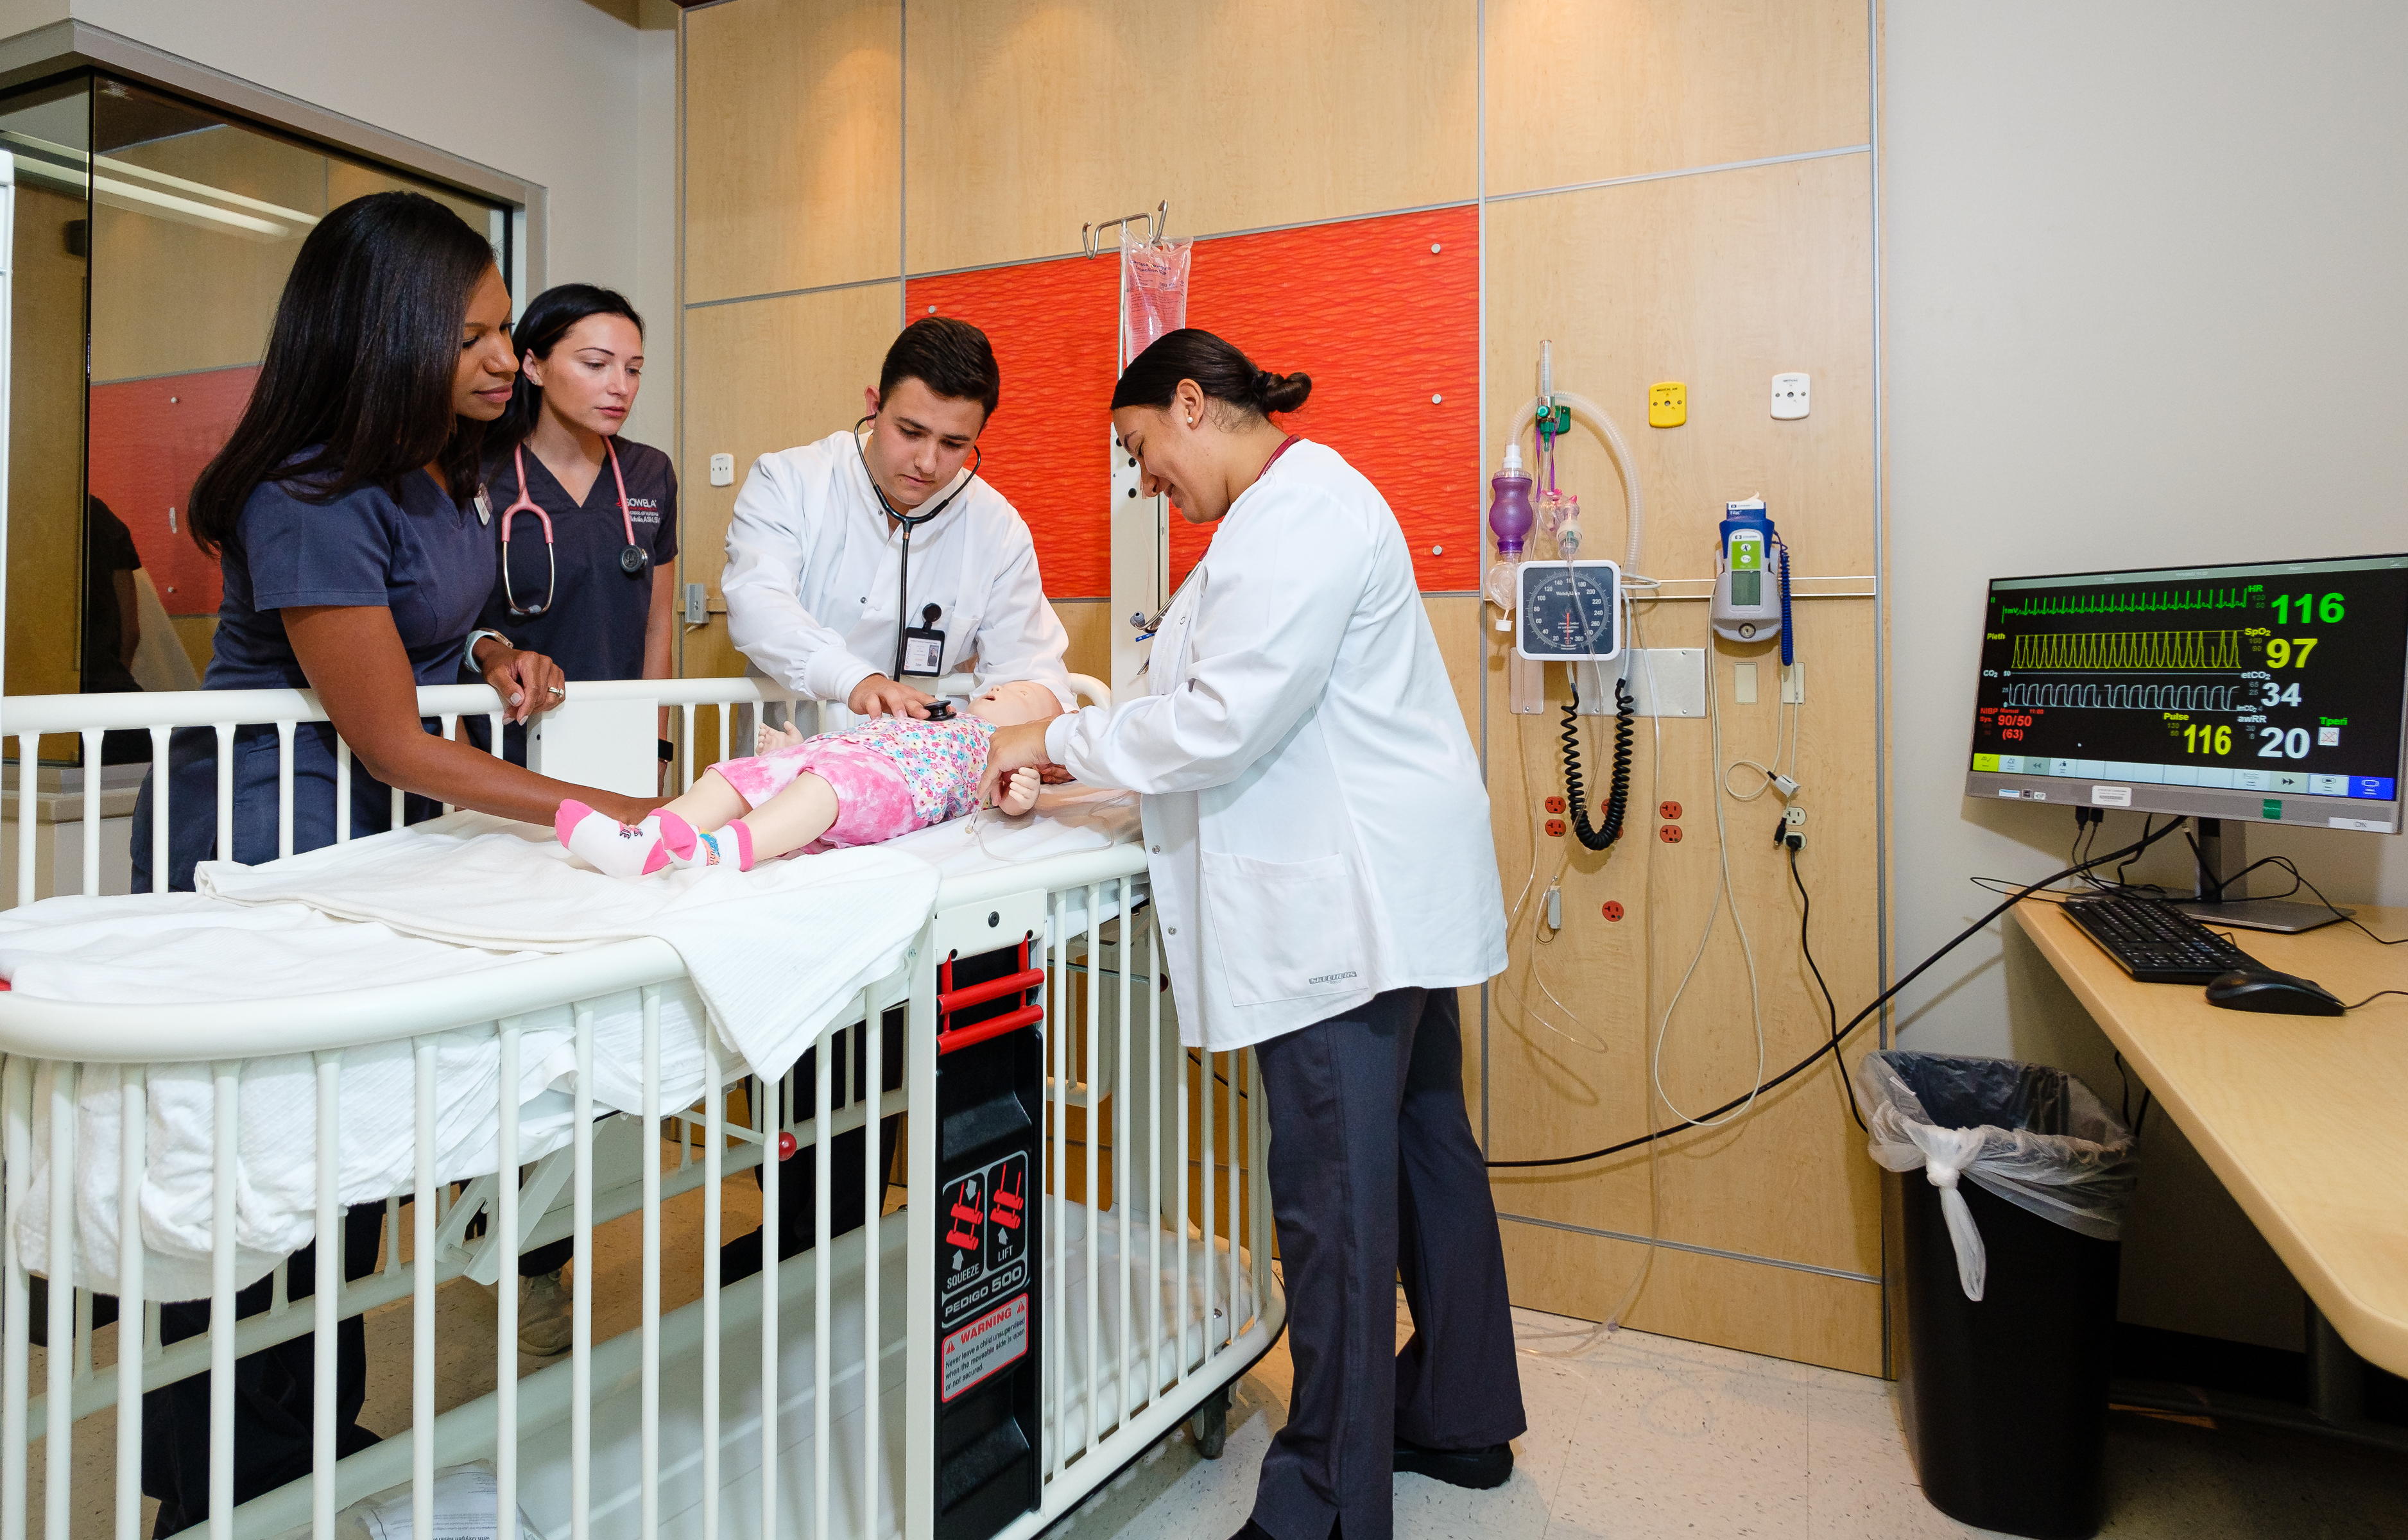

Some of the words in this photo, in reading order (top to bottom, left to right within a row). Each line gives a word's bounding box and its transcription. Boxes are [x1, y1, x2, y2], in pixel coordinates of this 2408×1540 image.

[626, 498, 657, 508] SOWELA
[2271, 592, 2345, 624] 116
[2266, 638, 2318, 669] 97
[2260, 682, 2303, 707] 34
[1998, 715, 2032, 726] 90/50
[2237, 715, 2267, 723] awRR
[2319, 717, 2348, 726] Tperi
[2002, 729, 2024, 741] (63)
[2183, 724, 2232, 755] 116
[2257, 726, 2310, 759] 20
[1309, 971, 1357, 984] SKECHERS
[998, 1245, 1013, 1262] LIFT
[947, 1263, 979, 1289] SQUEEZE
[945, 1286, 988, 1317] PEDIGO
[992, 1265, 1022, 1293] 500
[961, 1308, 1011, 1344] WARNING
[946, 1355, 961, 1369] Never
[962, 1348, 975, 1359] leave
[980, 1335, 992, 1349] child
[993, 1317, 1025, 1341] unsupervised
[946, 1367, 959, 1380] when
[971, 1347, 994, 1365] moveable
[996, 1339, 1006, 1350] side
[1013, 1328, 1024, 1340] open
[946, 1383, 951, 1391] or
[952, 1376, 961, 1387] not
[963, 1363, 983, 1381] secured.
